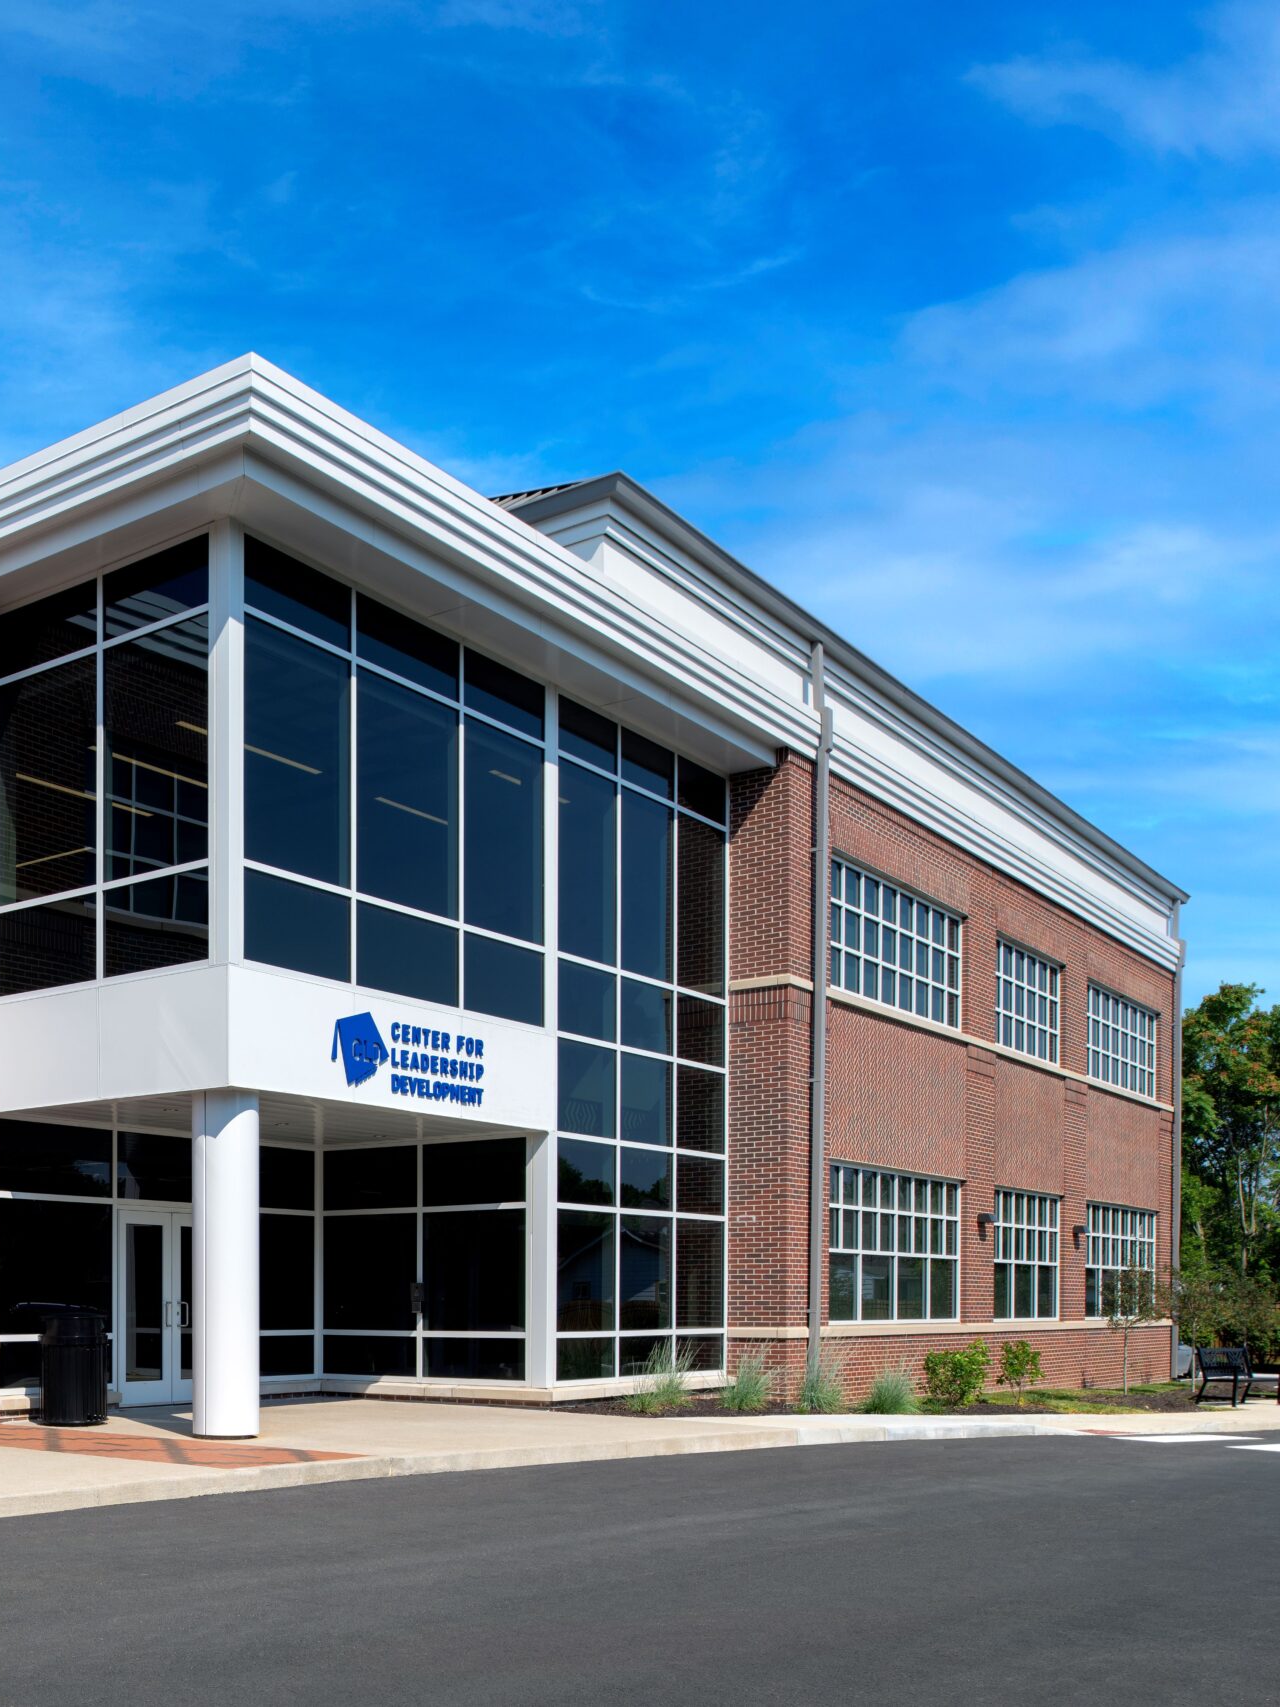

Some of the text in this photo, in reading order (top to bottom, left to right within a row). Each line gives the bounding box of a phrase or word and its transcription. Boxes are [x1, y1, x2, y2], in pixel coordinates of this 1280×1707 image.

[391, 1022, 484, 1058] CENTER FOR
[391, 1048, 484, 1082] LEADERSHIP
[391, 1074, 484, 1107] DEVELOPMENT
